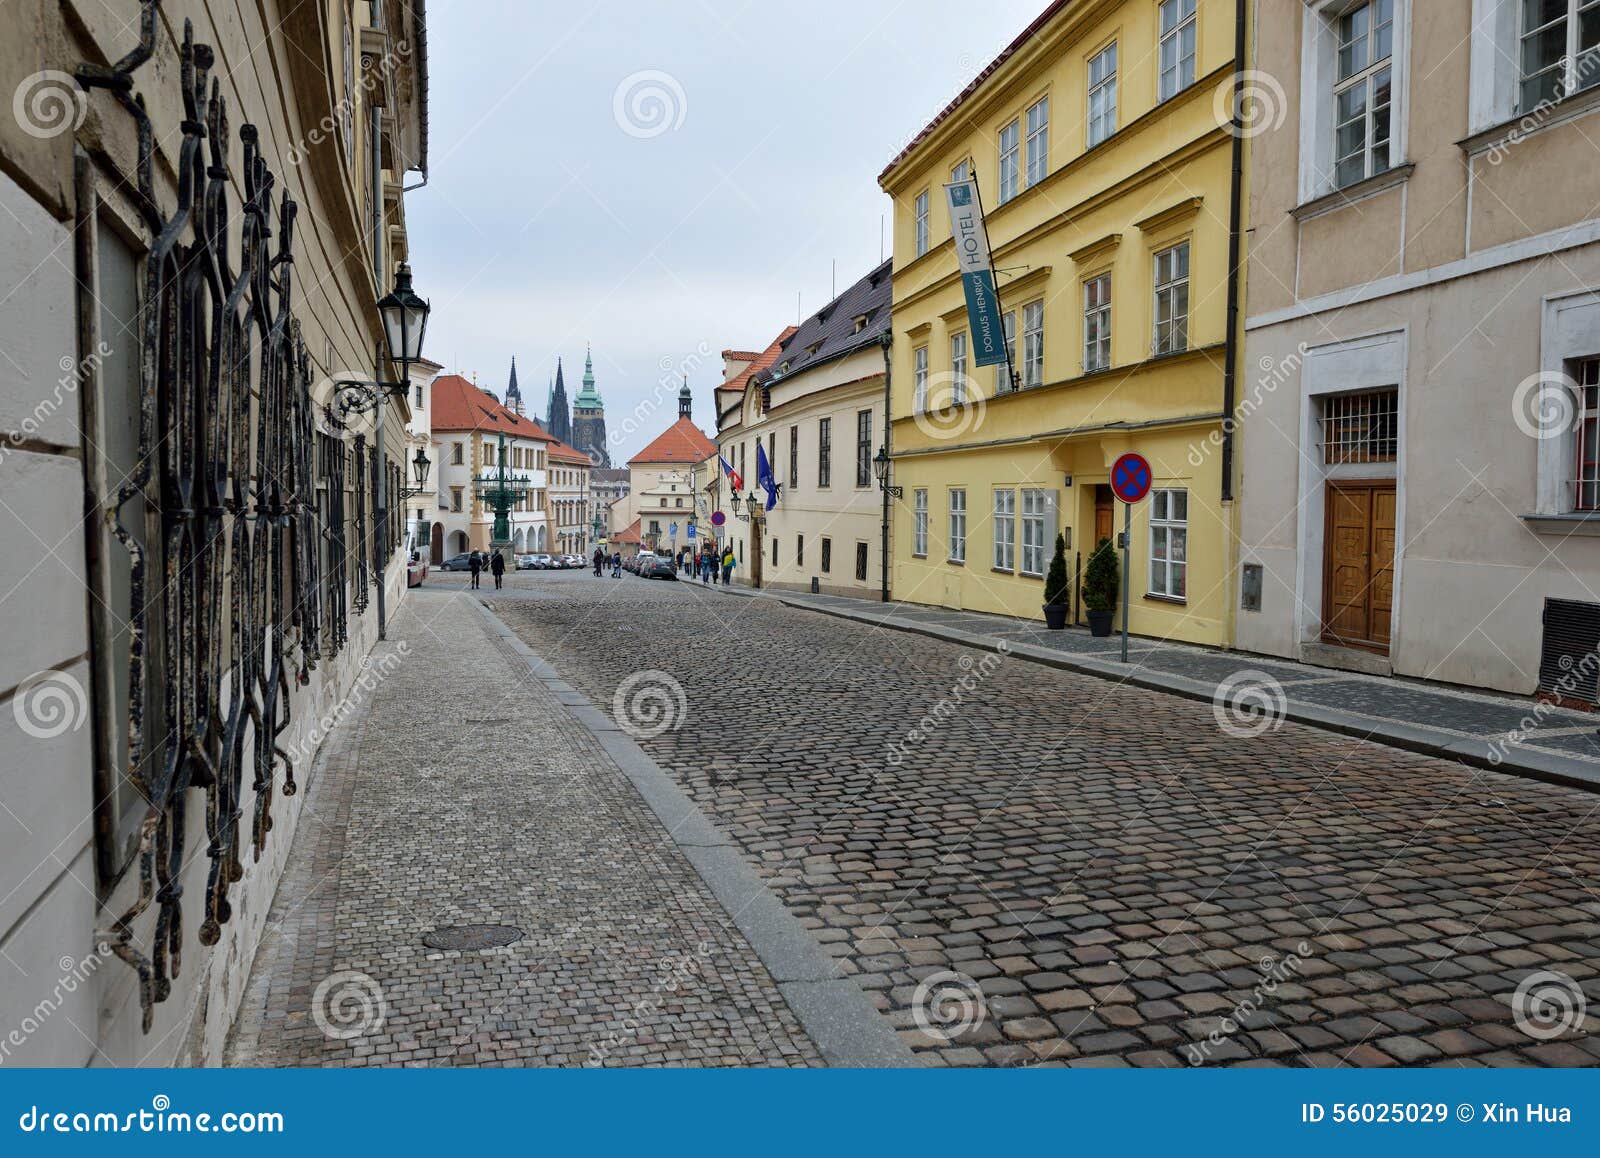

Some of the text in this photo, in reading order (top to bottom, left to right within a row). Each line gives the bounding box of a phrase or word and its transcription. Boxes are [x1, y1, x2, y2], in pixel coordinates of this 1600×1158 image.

[959, 212, 981, 265] HOTEL
[971, 273, 986, 313] HENRICI
[980, 315, 993, 353] DOMUS
